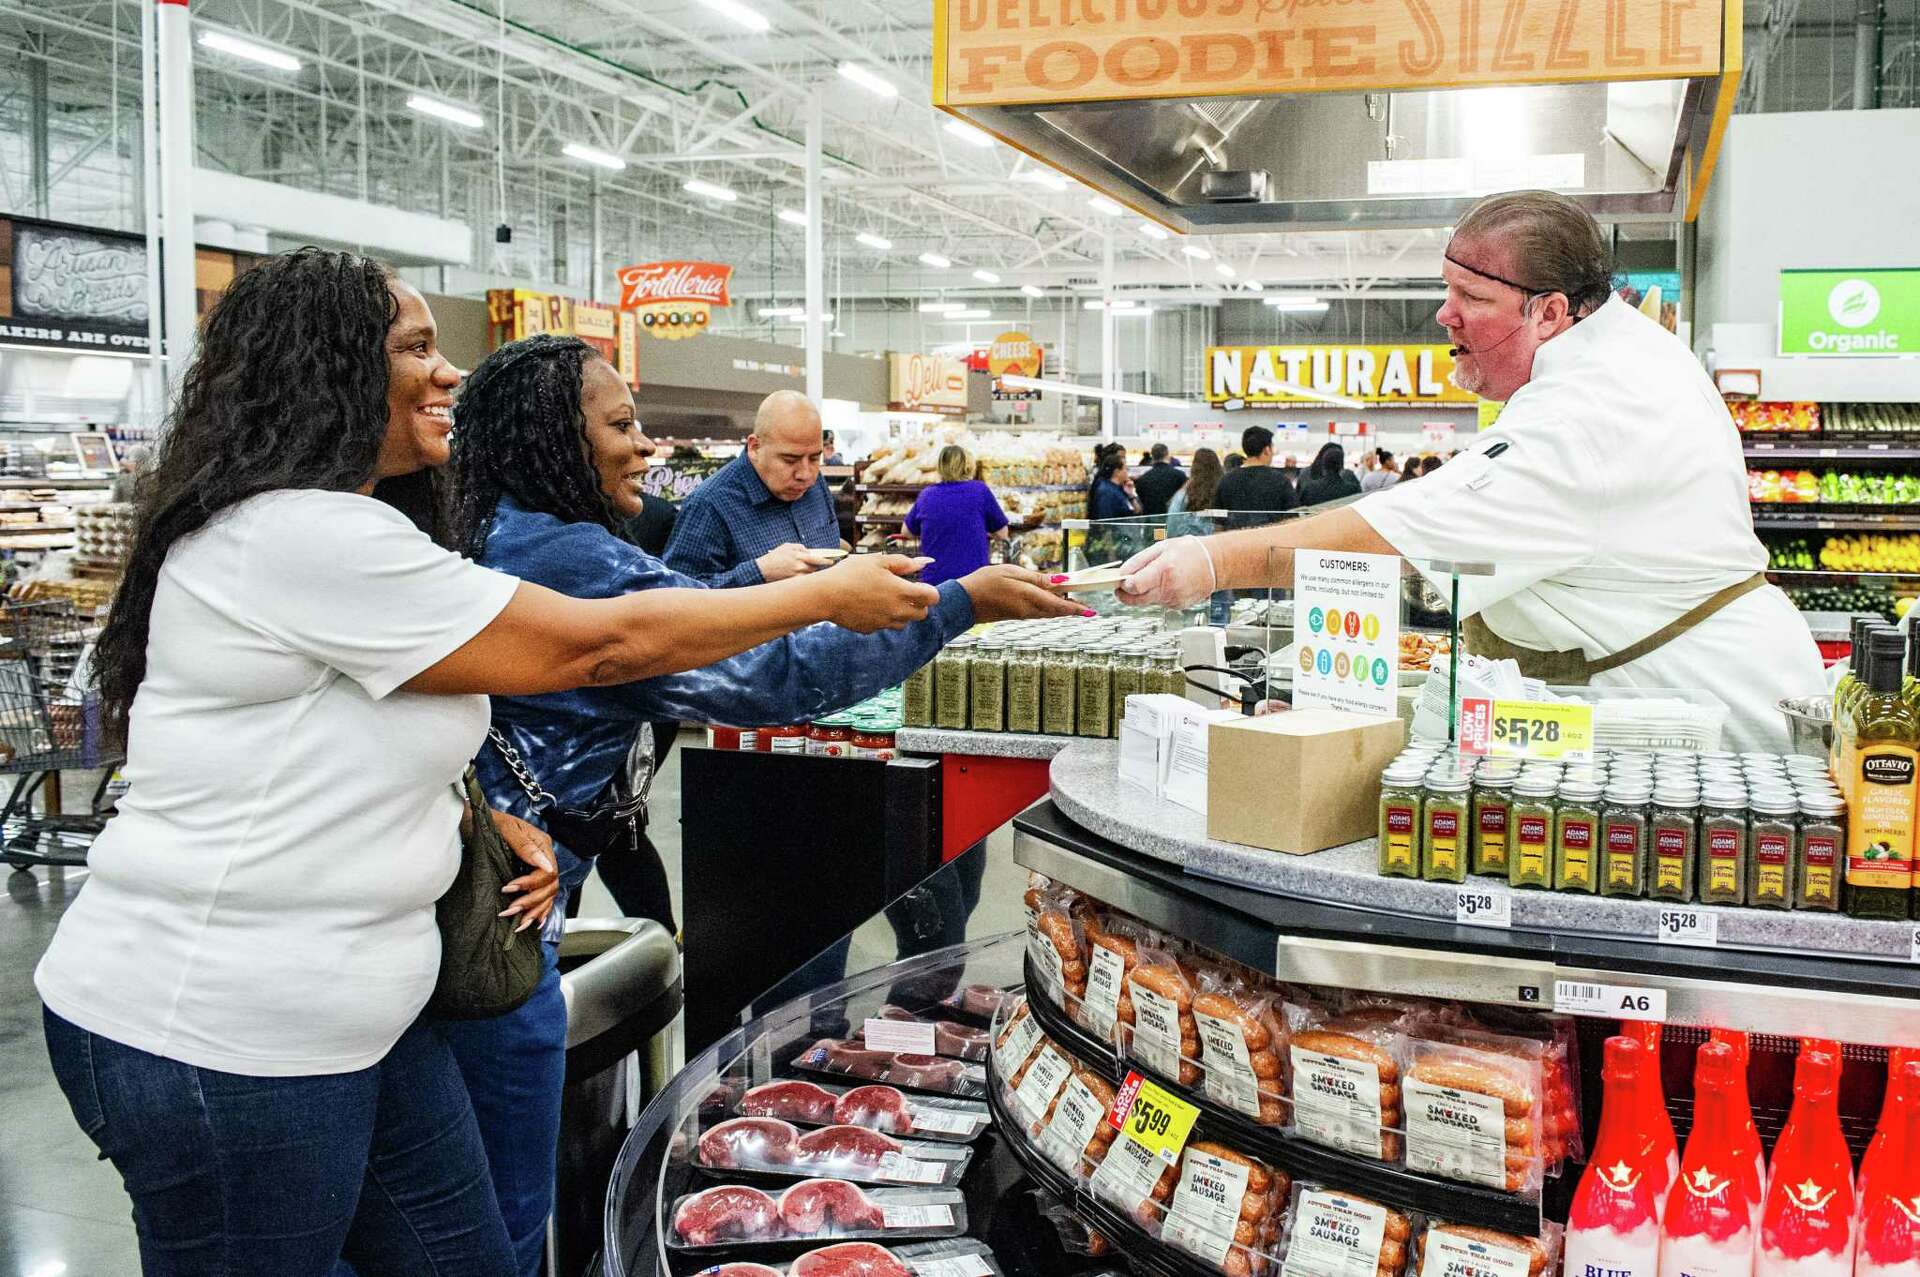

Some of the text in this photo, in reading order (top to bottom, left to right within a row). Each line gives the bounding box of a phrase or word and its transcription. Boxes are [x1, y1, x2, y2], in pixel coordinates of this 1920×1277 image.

[1400, 0, 1703, 76] SIZZLE
[958, 25, 1376, 94] FOODIE
[623, 265, 724, 304] Tortilleria
[67, 331, 106, 344] ARE
[1808, 330, 1898, 352] Organic
[904, 353, 943, 405] Deli
[1211, 349, 1444, 398] NATURAL
[1319, 558, 1371, 572] CUSTOMERS:
[1352, 579, 1374, 589] allergens
[1463, 711, 1475, 742] LOW
[1473, 703, 1486, 749] PRICES
[1865, 759, 1911, 771] OTTAVIO
[1390, 814, 1411, 822] ADAMS
[1565, 829, 1588, 837] ADAMS
[1660, 836, 1683, 845] ADAMS
[1712, 838, 1736, 846] ADAMS
[1760, 843, 1785, 851] ADAMS
[1808, 845, 1833, 853] ADAMS
[1620, 995, 1650, 1011] A6
[1114, 1083, 1130, 1113] LOW
[1116, 1079, 1140, 1124] PRICES
[1310, 1082, 1359, 1100] SAUSAGE
[1063, 1104, 1084, 1130] SAUSAGE
[1426, 1113, 1482, 1132] SAUSAGE
[1124, 1142, 1152, 1168] SAUSAGE
[1190, 1183, 1226, 1204] SAUSAGE
[1310, 1226, 1360, 1248] SAUSAGE
